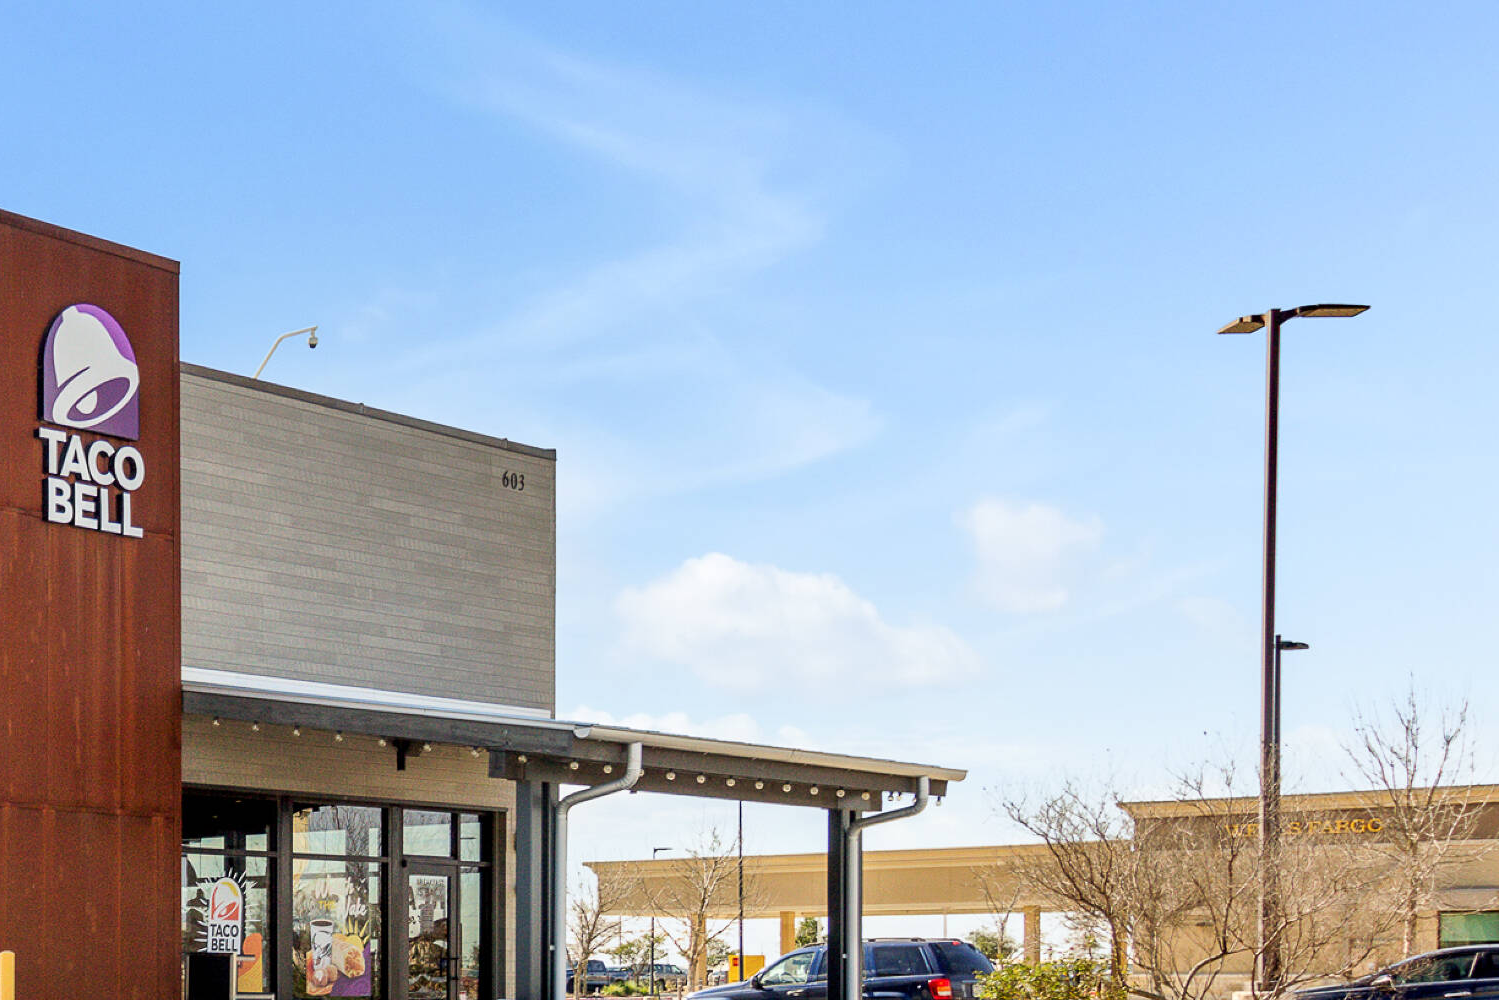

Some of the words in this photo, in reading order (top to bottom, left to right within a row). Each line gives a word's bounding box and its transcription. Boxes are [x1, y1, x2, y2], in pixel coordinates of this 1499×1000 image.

[37, 426, 145, 491] TACO
[502, 470, 525, 491] 603
[45, 477, 144, 538] BELL
[1307, 817, 1384, 835] FARGO
[210, 923, 239, 937] TACO
[211, 938, 237, 952] BELL
